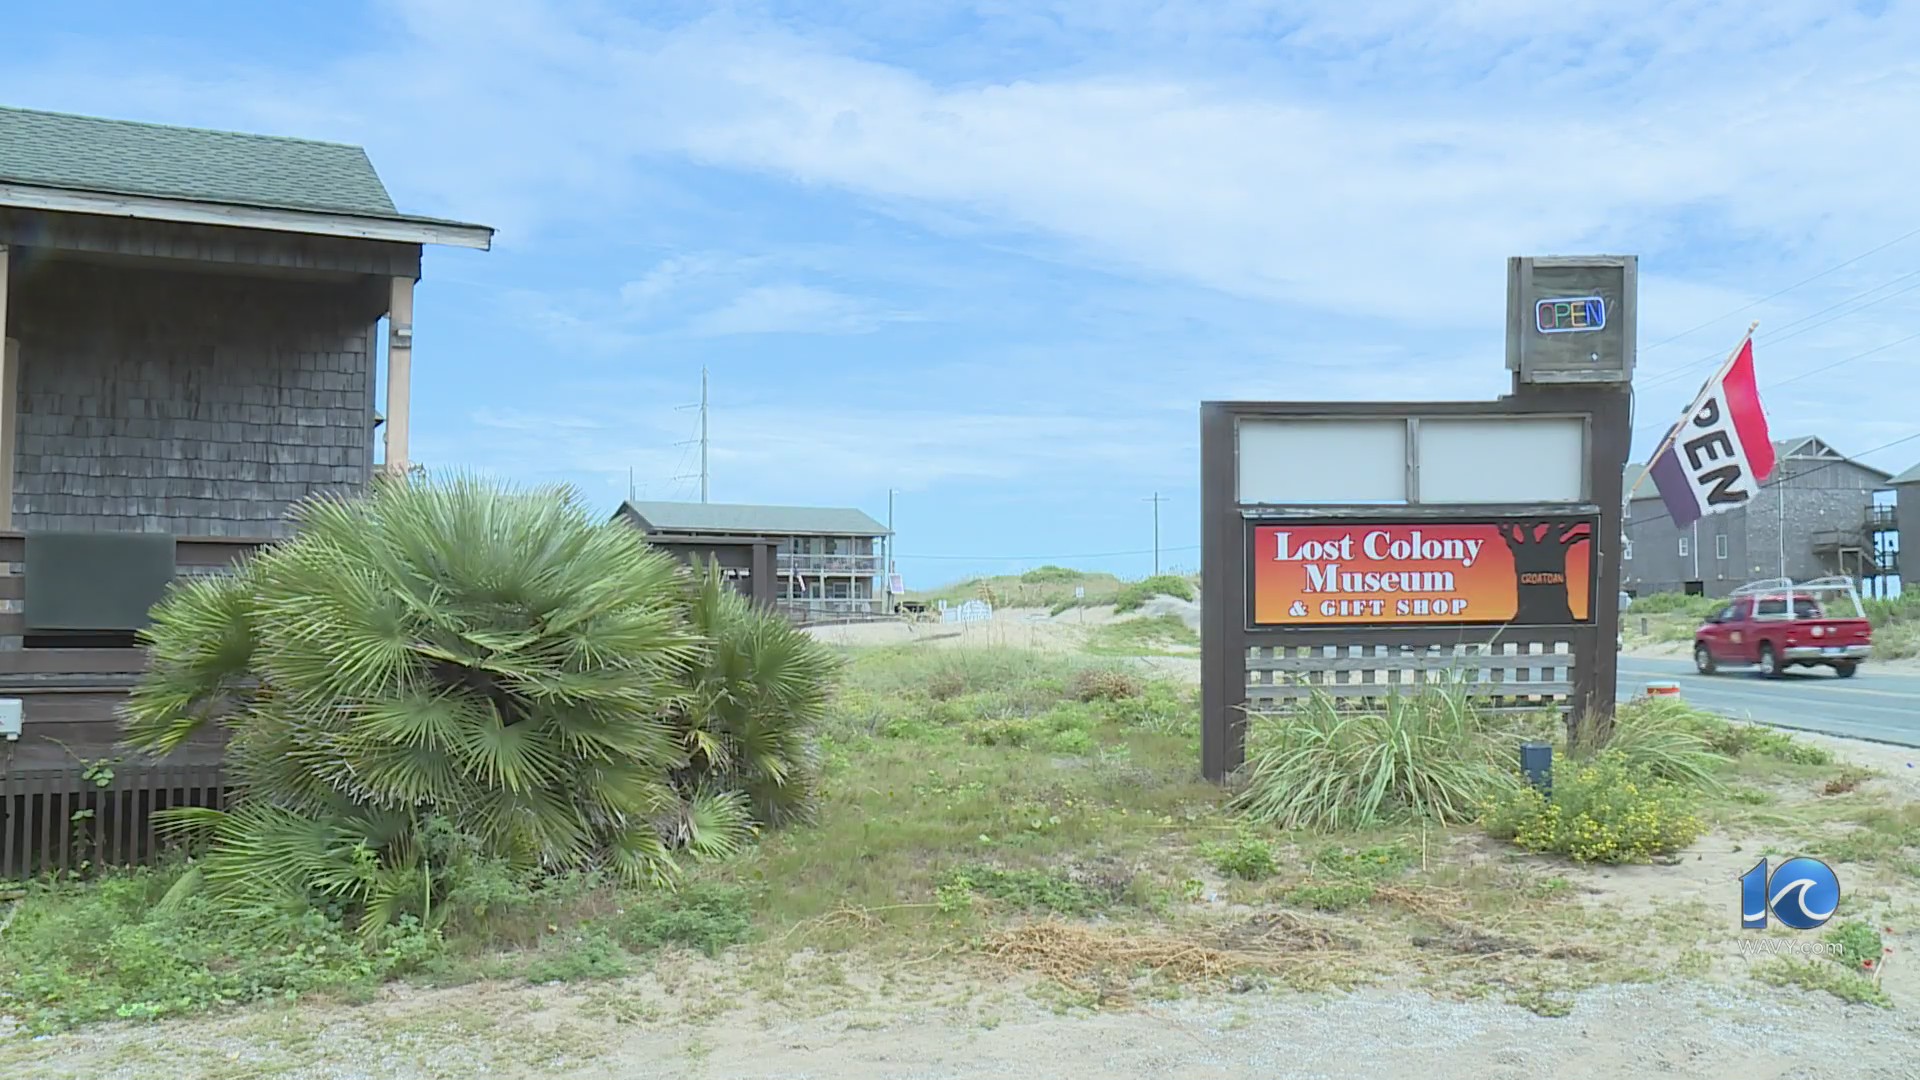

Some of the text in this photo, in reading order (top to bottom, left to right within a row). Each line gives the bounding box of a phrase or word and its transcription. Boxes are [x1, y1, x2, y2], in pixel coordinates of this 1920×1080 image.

[1540, 302, 1602, 328] OPEN
[1684, 398, 1750, 506] PEN
[1274, 531, 1484, 567] Lost Colony
[1302, 563, 1455, 593] Museum
[1289, 599, 1468, 617] & GIFT SHOP
